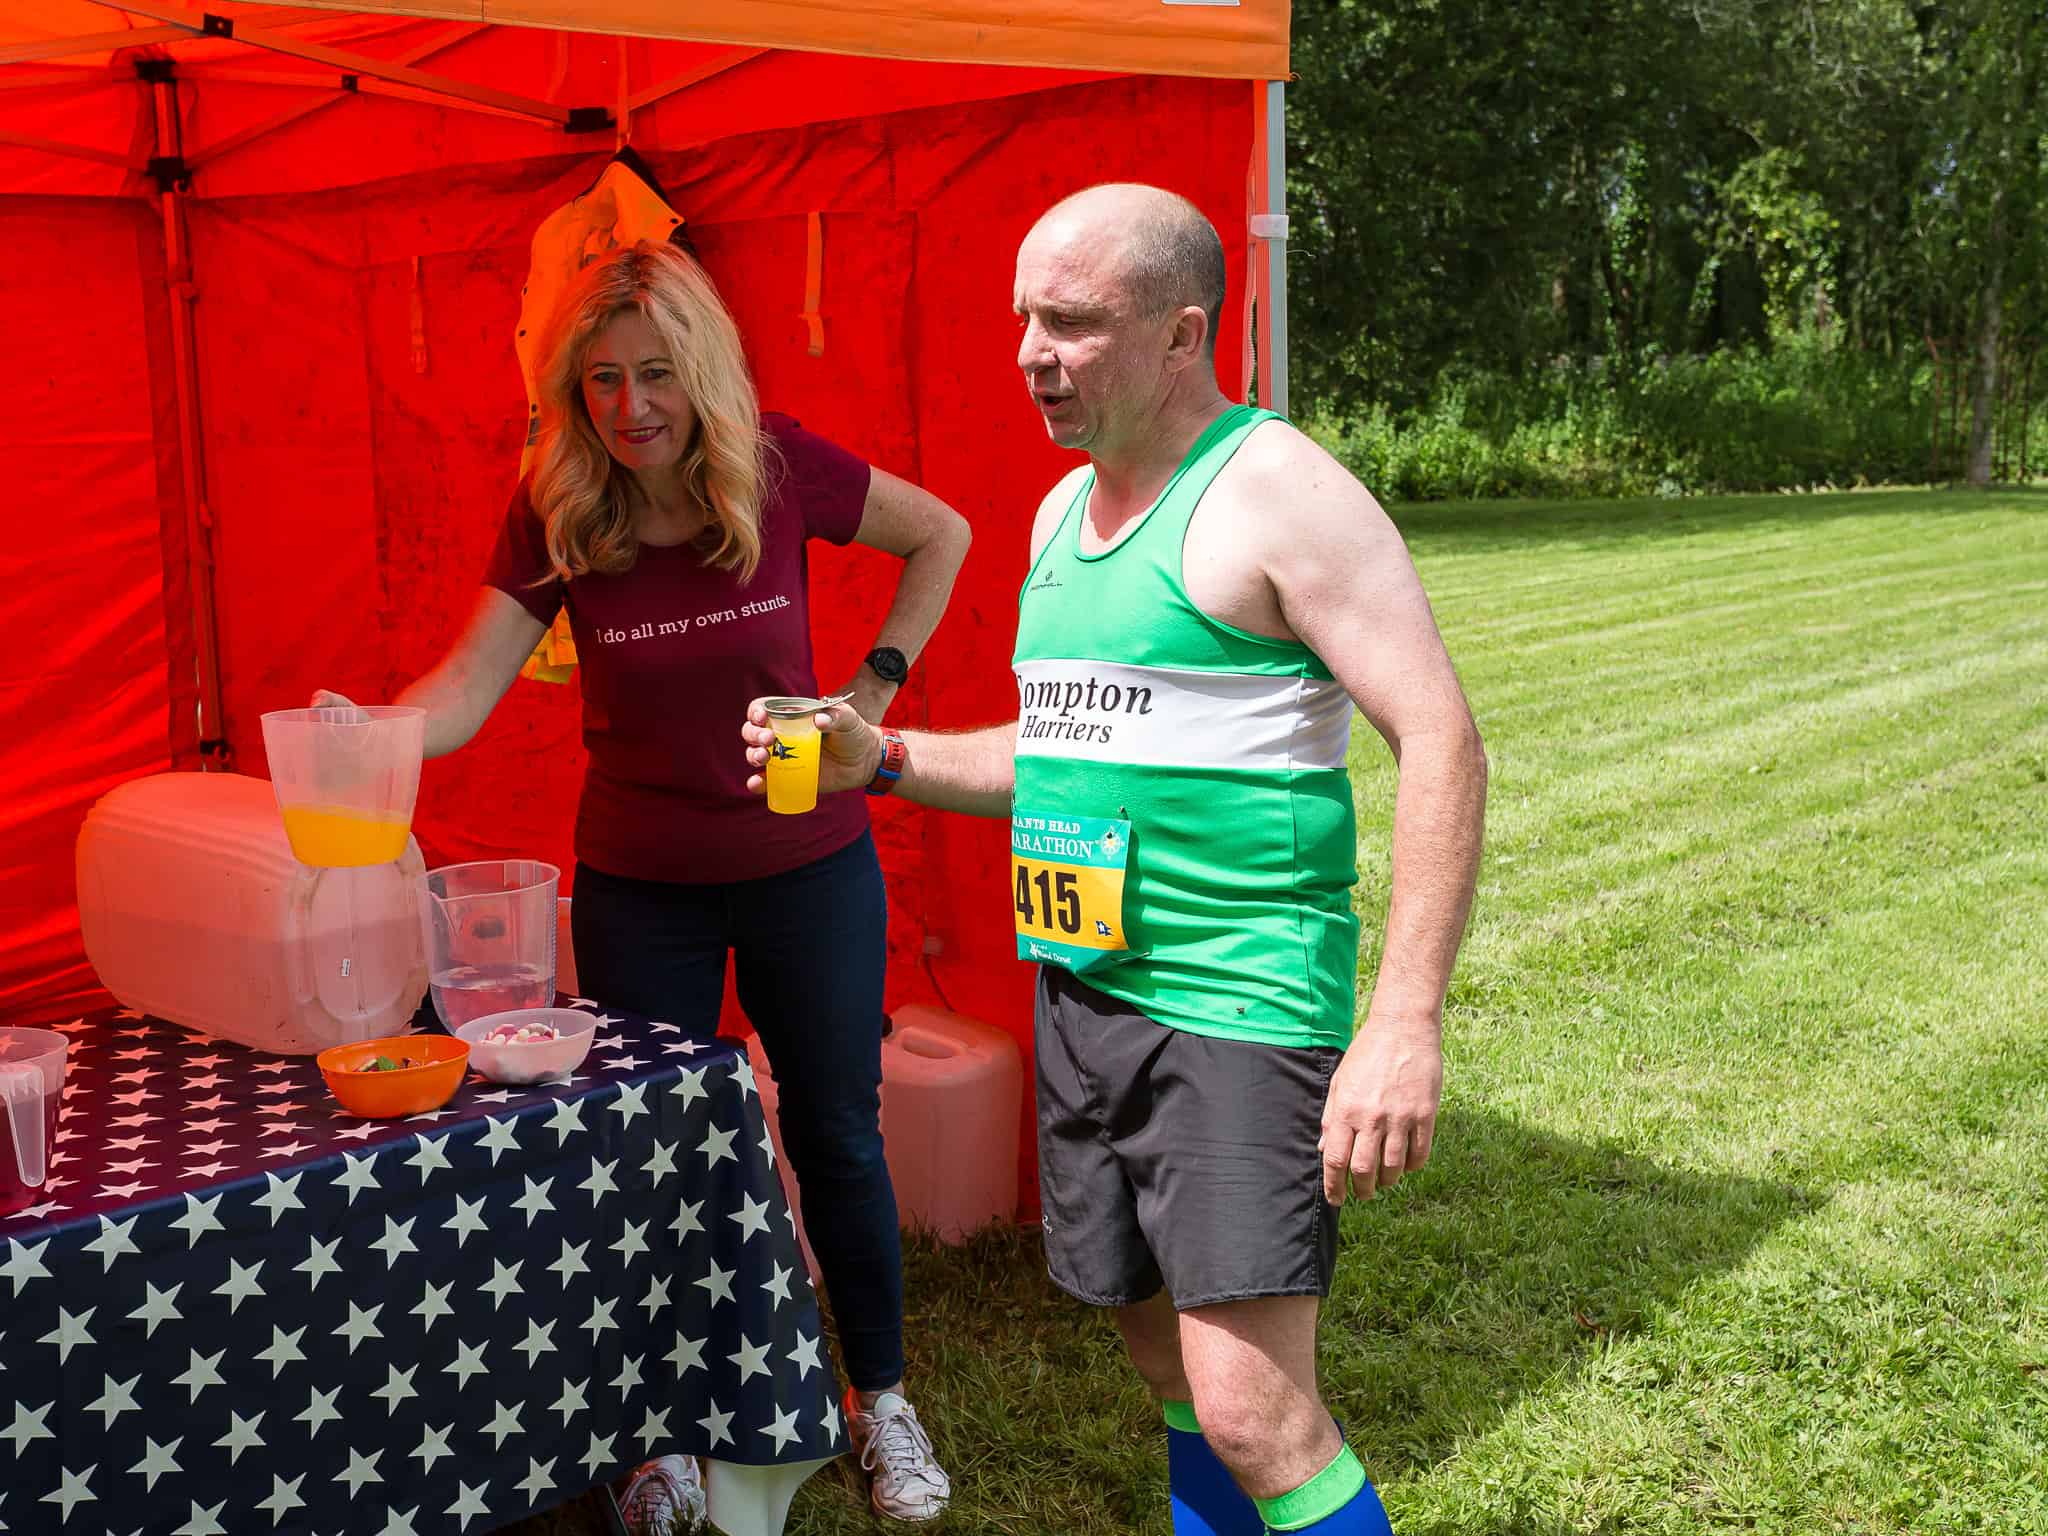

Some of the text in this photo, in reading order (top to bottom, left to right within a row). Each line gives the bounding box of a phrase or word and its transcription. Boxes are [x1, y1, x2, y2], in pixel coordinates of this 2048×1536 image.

[596, 594, 791, 643] I do all my own stunts.
[1017, 674, 1153, 717] ompton
[1021, 715, 1113, 744] Harriers
[1013, 832, 1094, 859] ARATHON
[1048, 820, 1081, 835] HEAD
[1016, 864, 1081, 934] 415
